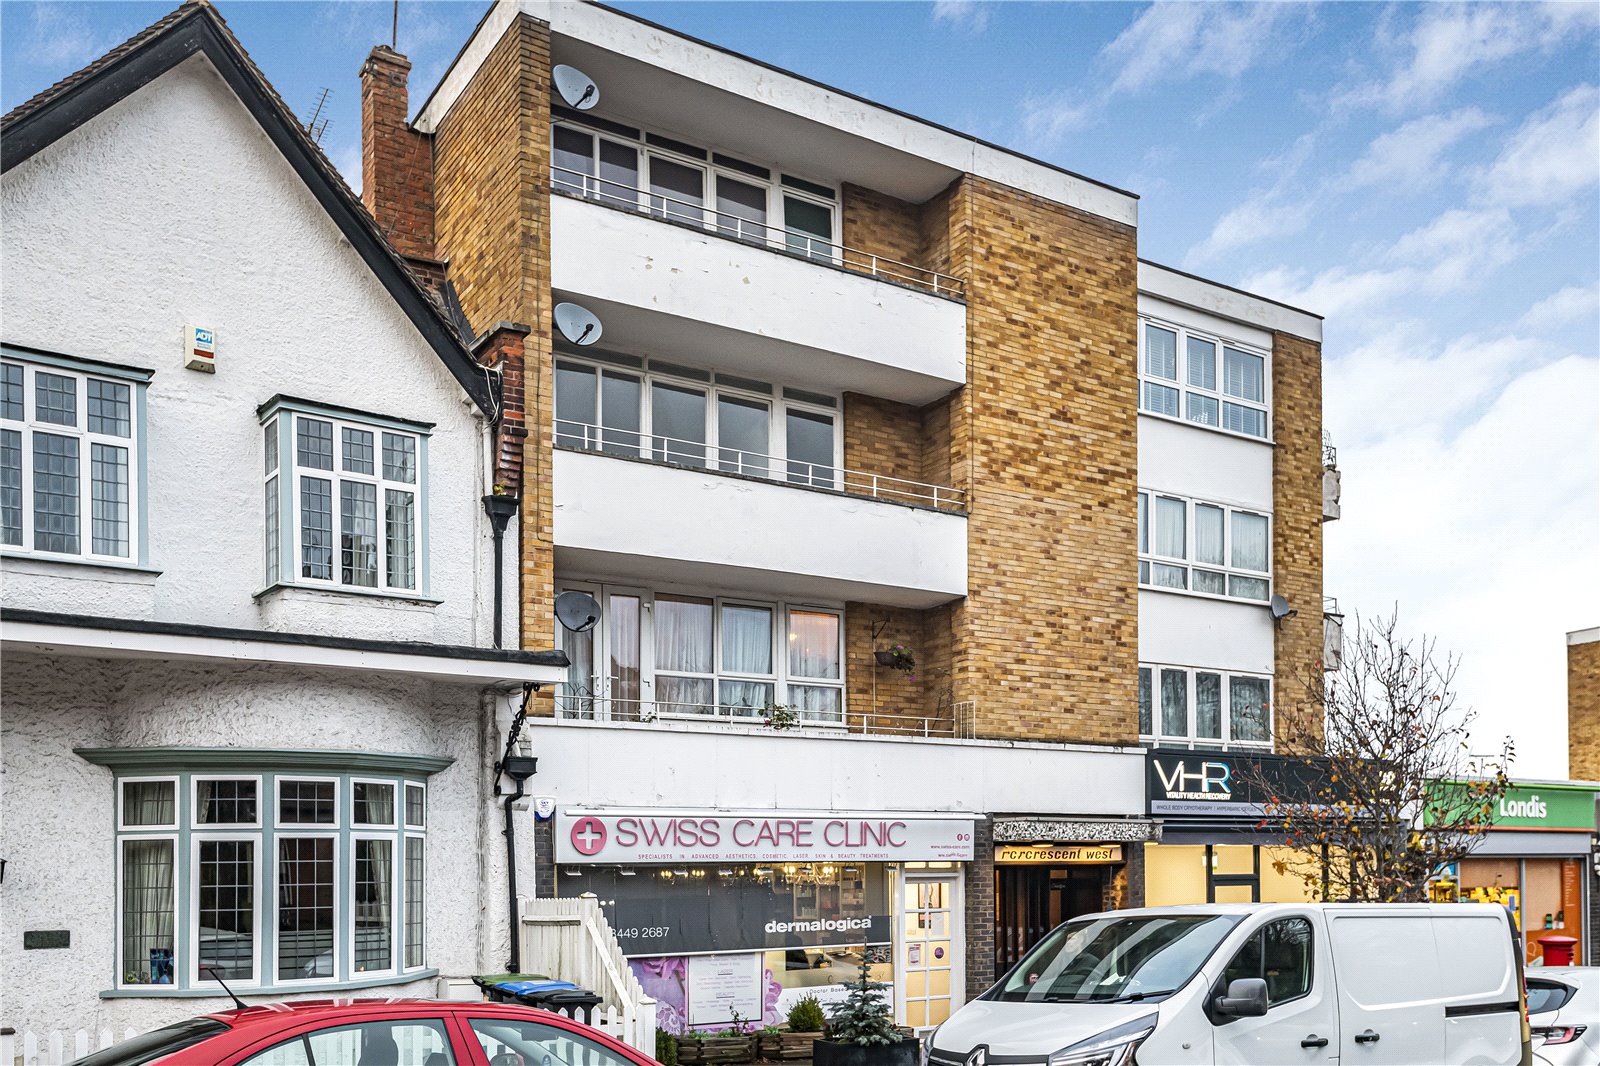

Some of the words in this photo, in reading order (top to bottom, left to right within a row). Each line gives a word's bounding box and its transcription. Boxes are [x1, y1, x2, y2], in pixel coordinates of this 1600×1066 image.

[196, 331, 212, 342] ADT
[1153, 759, 1231, 793] VHR
[1500, 795, 1547, 818] Londis
[616, 818, 721, 847] SWISS
[733, 819, 814, 848] CARE
[824, 821, 907, 848] CLINIC
[1086, 848, 1112, 859] west
[641, 927, 670, 938] 2687
[764, 917, 871, 933] dermalogica
